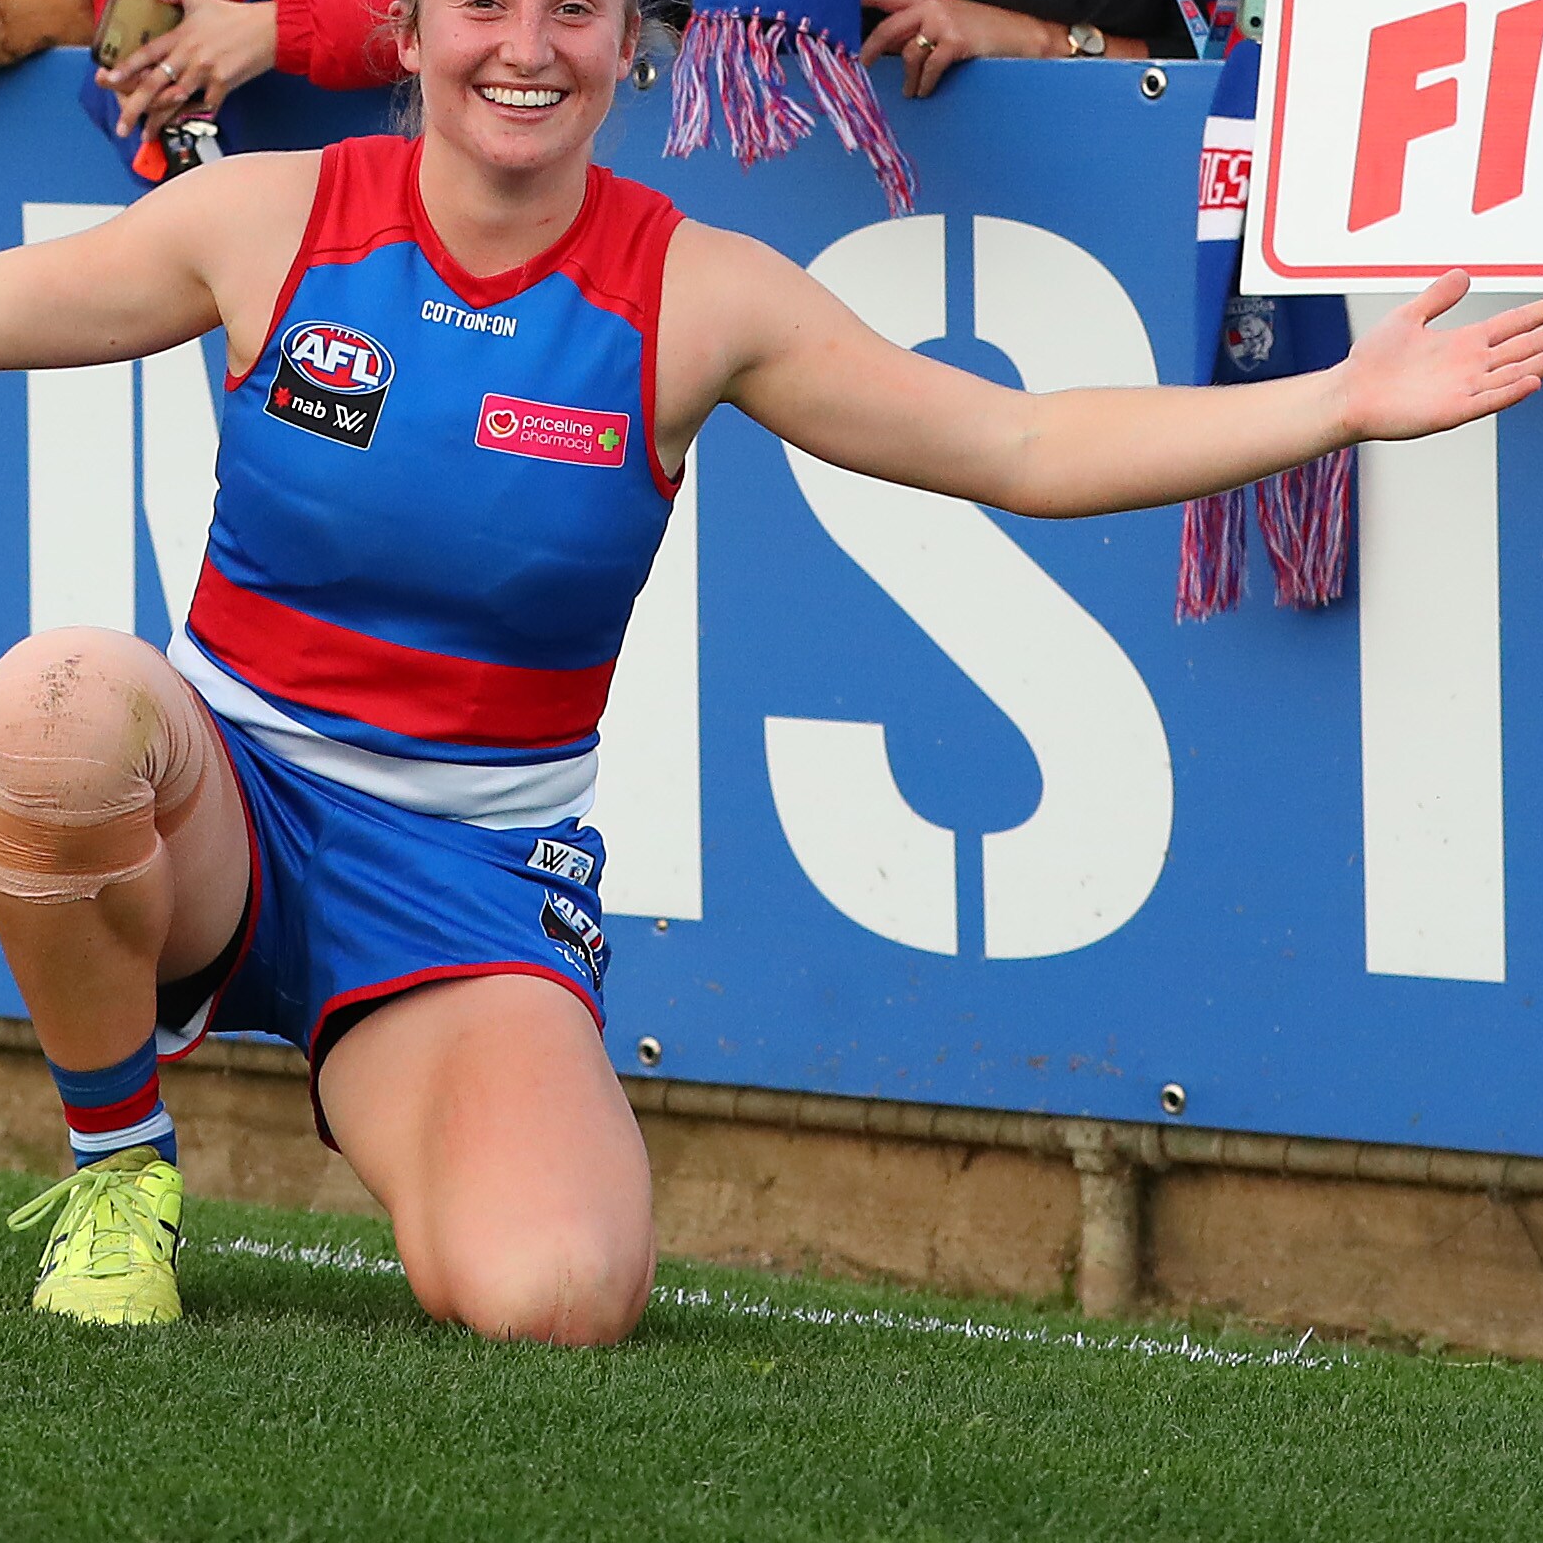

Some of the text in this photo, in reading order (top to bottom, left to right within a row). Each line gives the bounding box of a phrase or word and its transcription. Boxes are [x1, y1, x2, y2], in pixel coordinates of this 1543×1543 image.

[421, 300, 517, 337] COTTON:ON
[291, 332, 379, 387] AFL
[291, 395, 327, 420] nab
[522, 415, 594, 437] priceline
[520, 429, 593, 455] pharmacy
